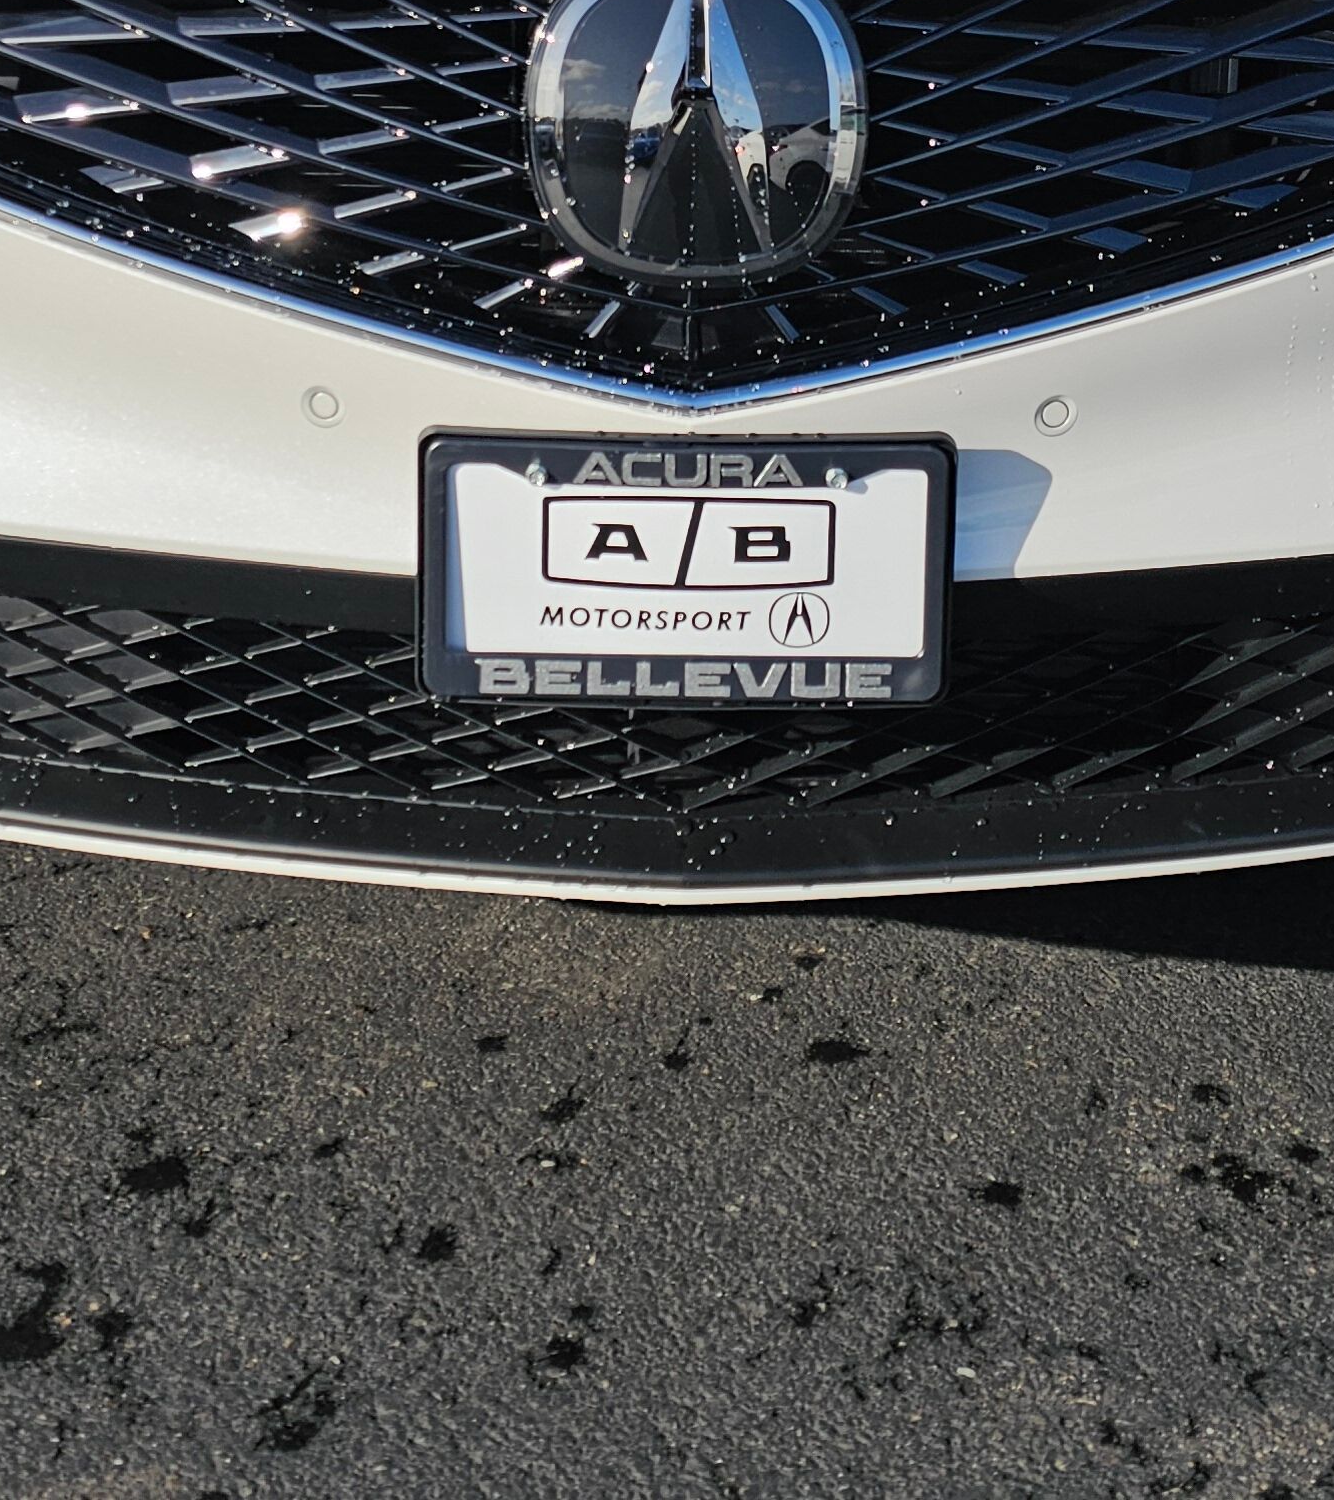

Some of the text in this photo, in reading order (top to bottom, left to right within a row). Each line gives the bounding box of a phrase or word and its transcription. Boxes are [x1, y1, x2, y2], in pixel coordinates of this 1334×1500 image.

[571, 451, 803, 488] ACURA
[539, 605, 752, 632] MOTORSPORT
[473, 657, 893, 699] BELLEVUE
